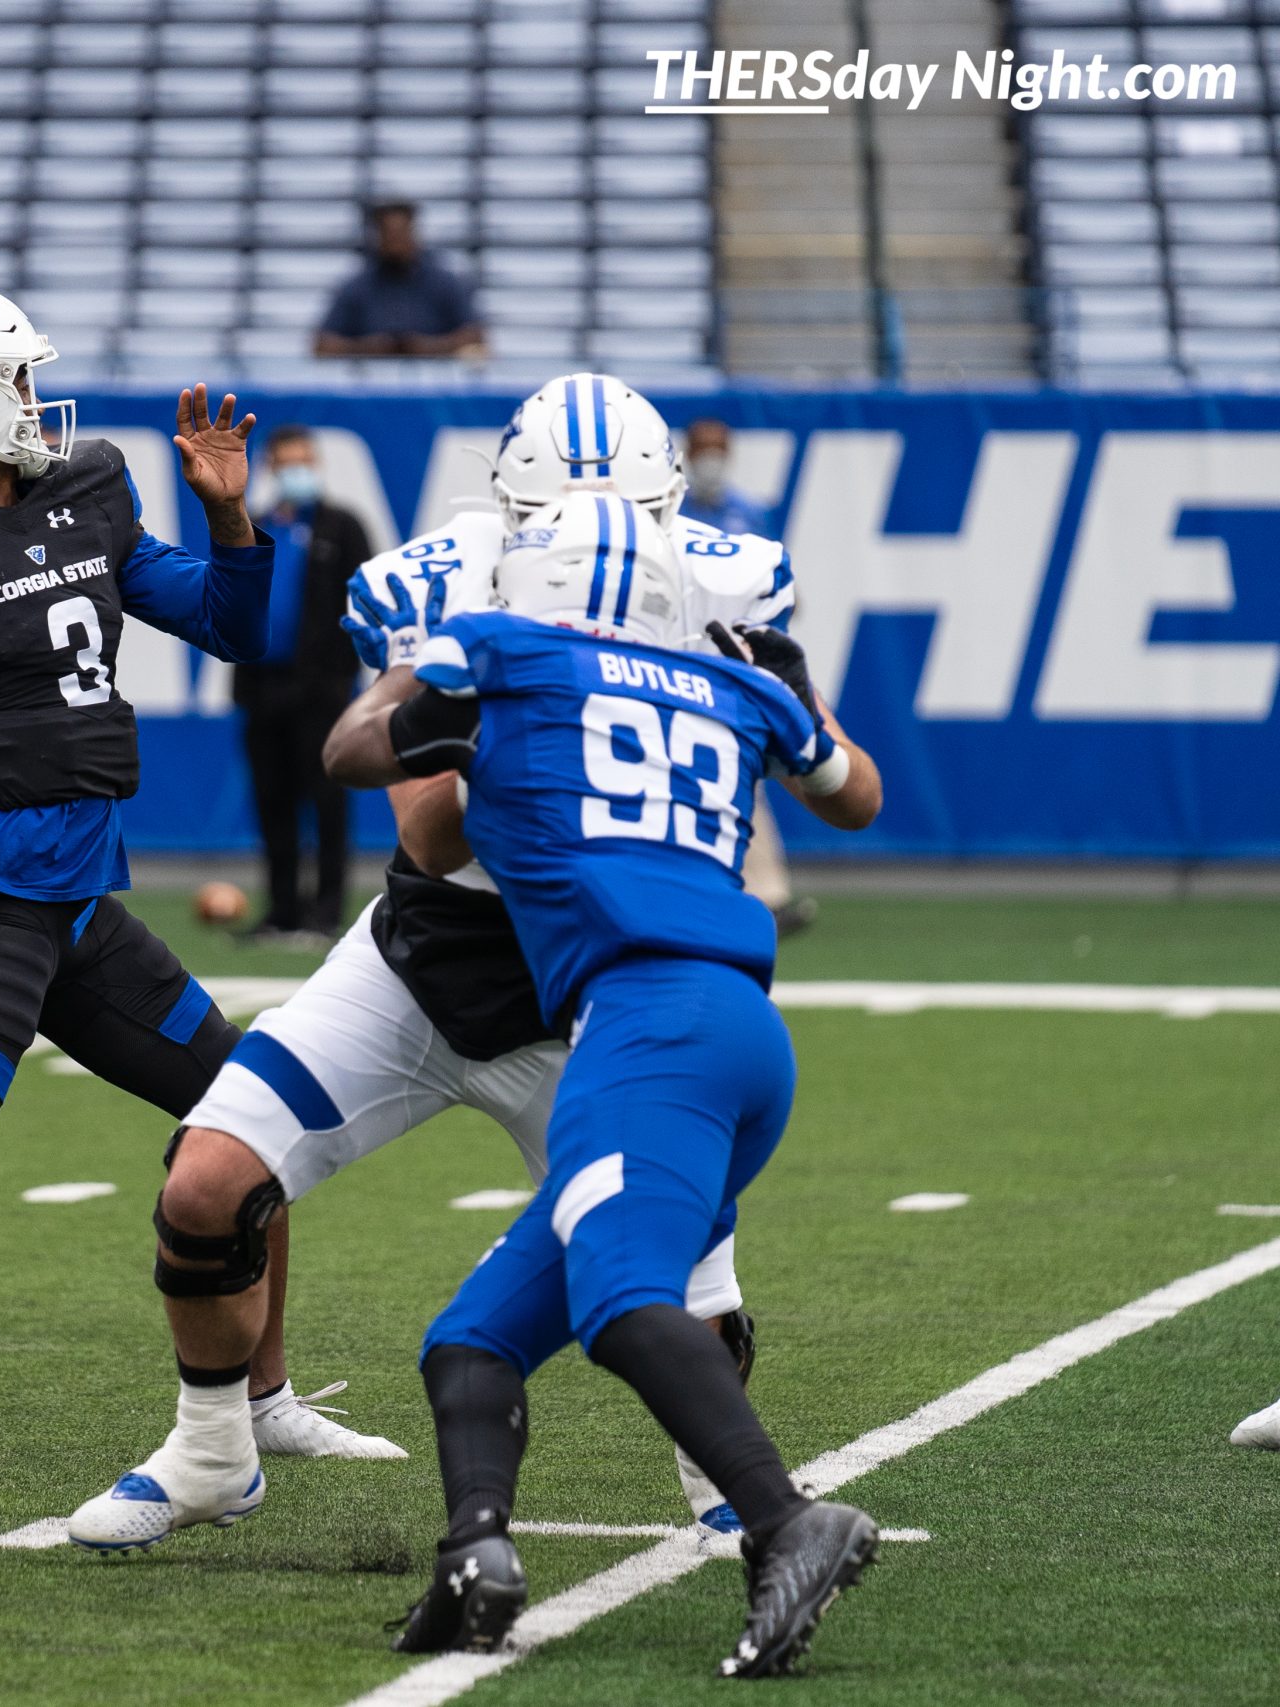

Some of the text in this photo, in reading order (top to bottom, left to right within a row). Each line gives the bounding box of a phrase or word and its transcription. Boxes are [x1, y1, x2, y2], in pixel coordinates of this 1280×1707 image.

[62, 555, 109, 583] STATE
[402, 538, 462, 584] 64
[47, 596, 111, 707] 3
[597, 651, 715, 708] BUTLER
[581, 692, 740, 869] 93
